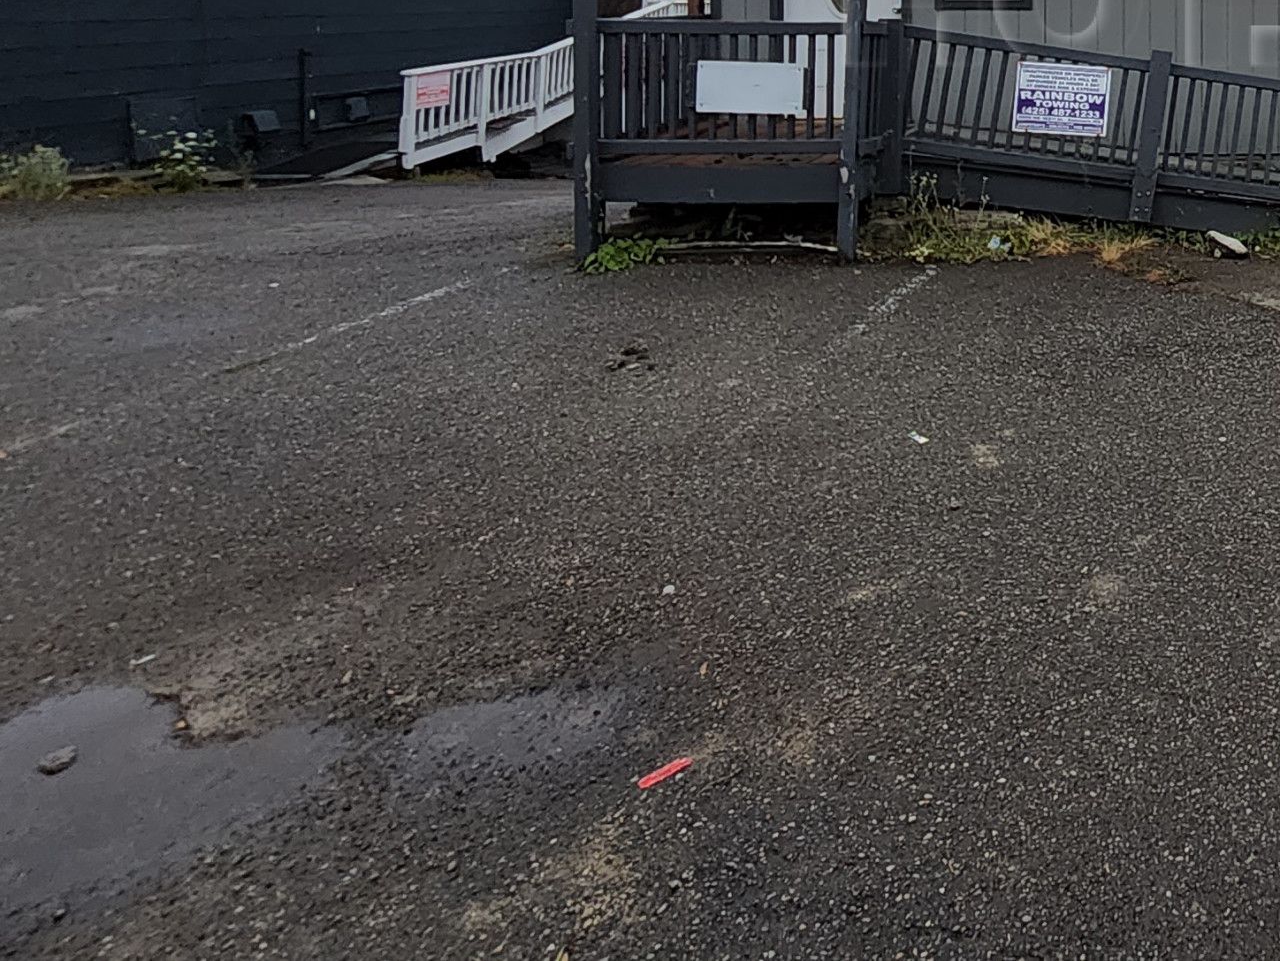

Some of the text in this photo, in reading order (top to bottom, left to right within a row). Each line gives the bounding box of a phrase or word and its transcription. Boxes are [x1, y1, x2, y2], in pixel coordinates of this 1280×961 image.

[1019, 90, 1104, 105] RAINBOW
[1033, 99, 1090, 110] TOWING
[1021, 106, 1100, 118] (425) 487-1233
